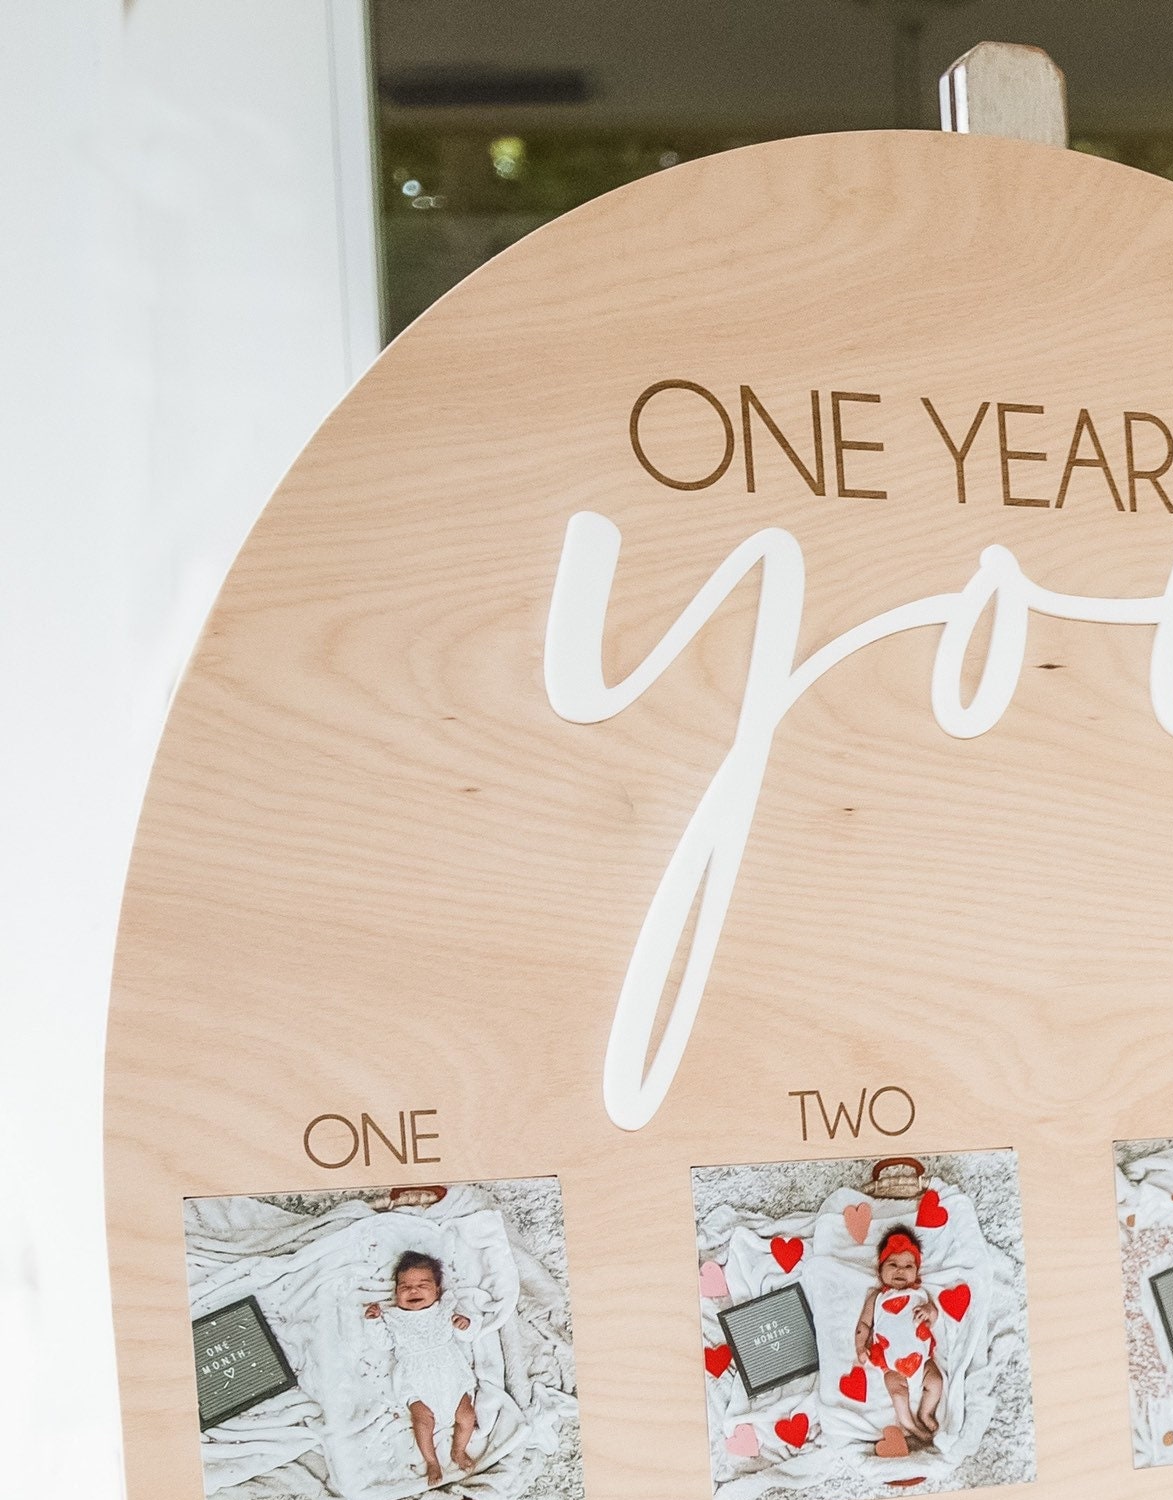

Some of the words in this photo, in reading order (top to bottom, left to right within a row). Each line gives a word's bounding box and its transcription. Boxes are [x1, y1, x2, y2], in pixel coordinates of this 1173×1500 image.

[630, 380, 887, 499] ONE
[789, 1086, 915, 1141] TWO
[304, 1110, 440, 1169] ONE
[754, 1326, 790, 1346] MONTHS
[759, 1321, 778, 1333] TWO
[206, 1341, 229, 1356] ONE
[202, 1349, 246, 1374] MONTH
